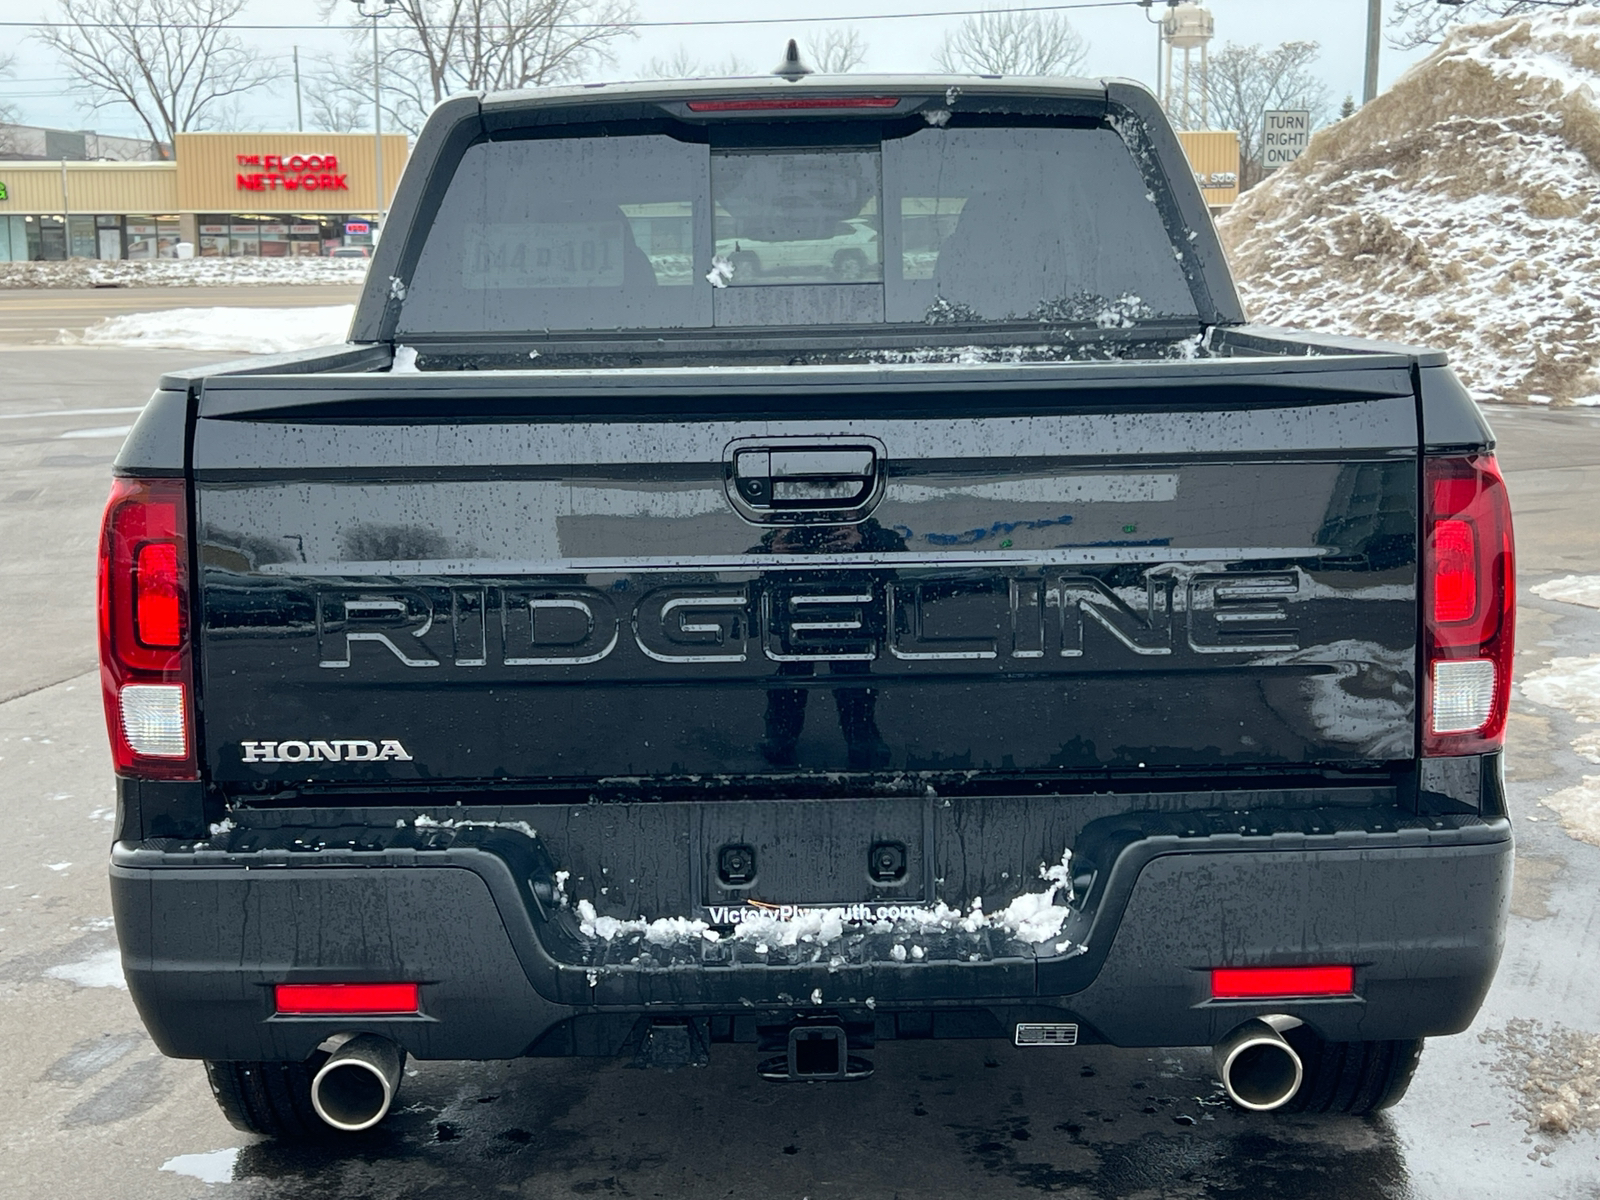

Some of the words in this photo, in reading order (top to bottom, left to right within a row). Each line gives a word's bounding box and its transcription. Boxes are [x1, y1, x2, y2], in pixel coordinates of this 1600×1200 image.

[1269, 116, 1304, 129] TURN
[1266, 133, 1305, 145] RIGHT
[236, 154, 260, 166] THE
[264, 155, 338, 172] FLOOR
[1267, 149, 1302, 162] ONLY
[236, 173, 349, 191] NETWORK
[318, 569, 1301, 669] RIDGELINE
[240, 739, 414, 763] HONDA
[708, 903, 918, 924] VictoryPlyuth.com
